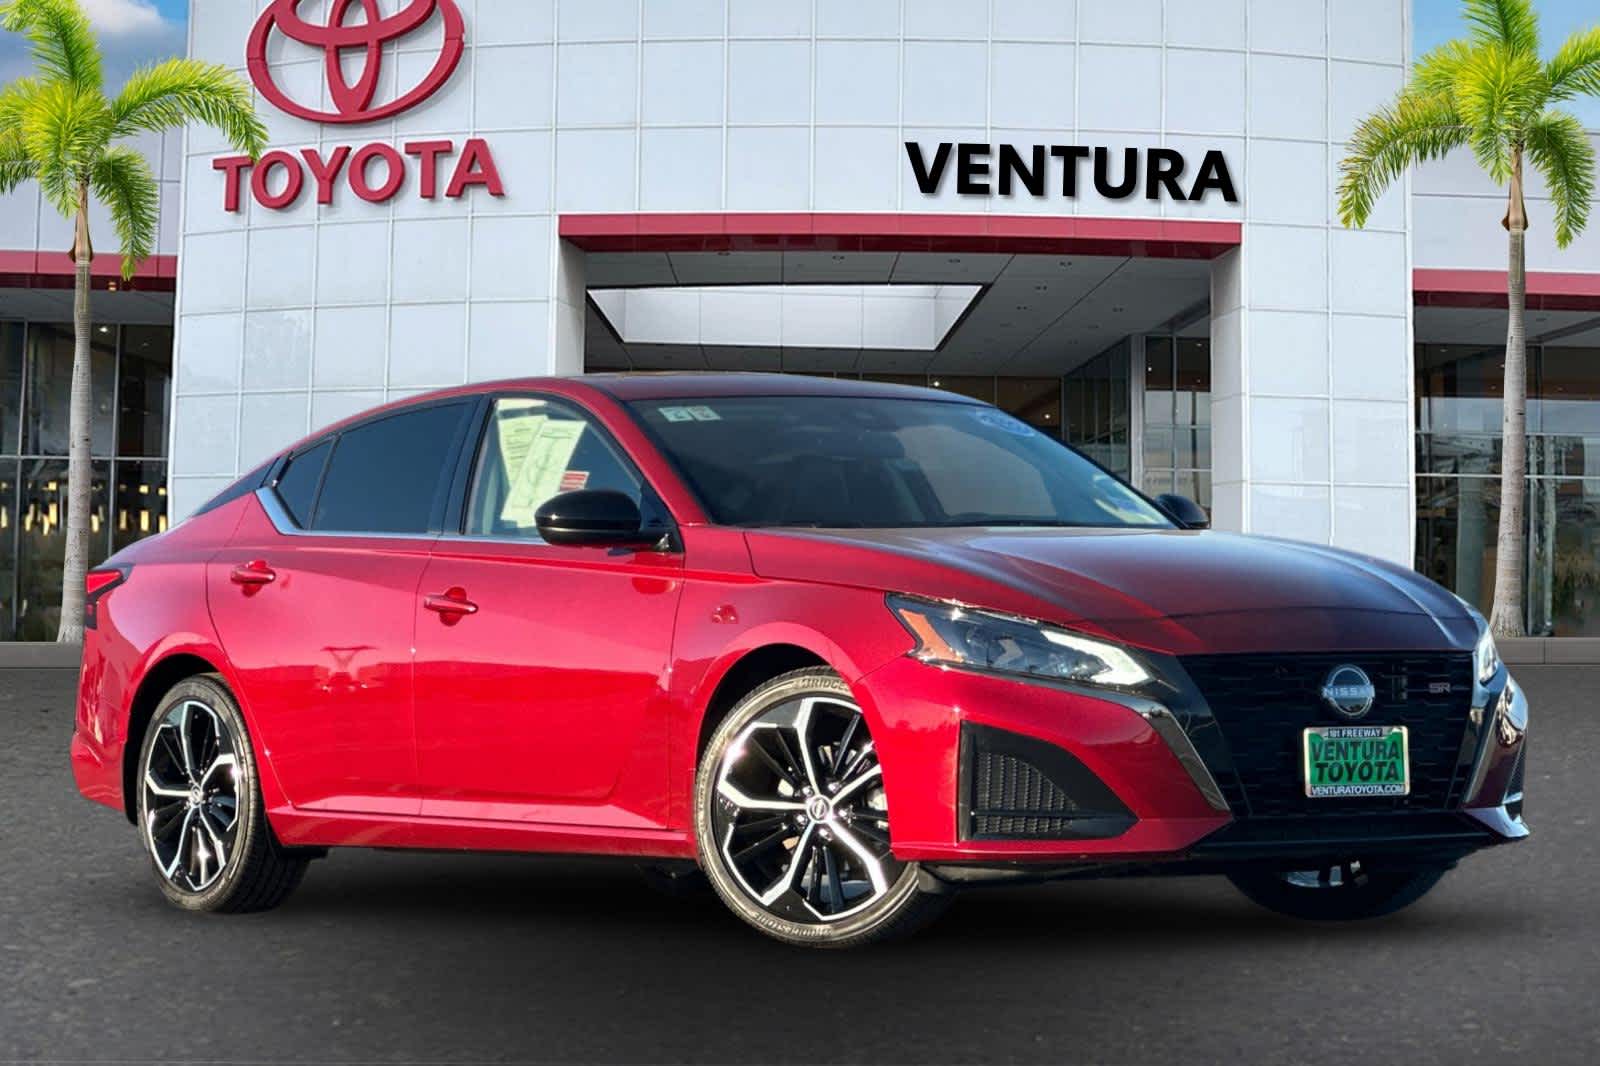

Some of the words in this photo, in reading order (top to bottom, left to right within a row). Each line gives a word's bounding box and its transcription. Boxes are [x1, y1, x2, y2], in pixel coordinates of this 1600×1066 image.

[212, 138, 505, 212] TOYOTA
[904, 142, 1239, 203] VENTURA
[1429, 683, 1450, 693] SR
[1341, 728, 1381, 738] FREEWAY
[1311, 740, 1400, 761] VENTURA
[1315, 761, 1399, 782] TOYOTA
[1312, 784, 1404, 796] VENTURATOYOTA.COM
